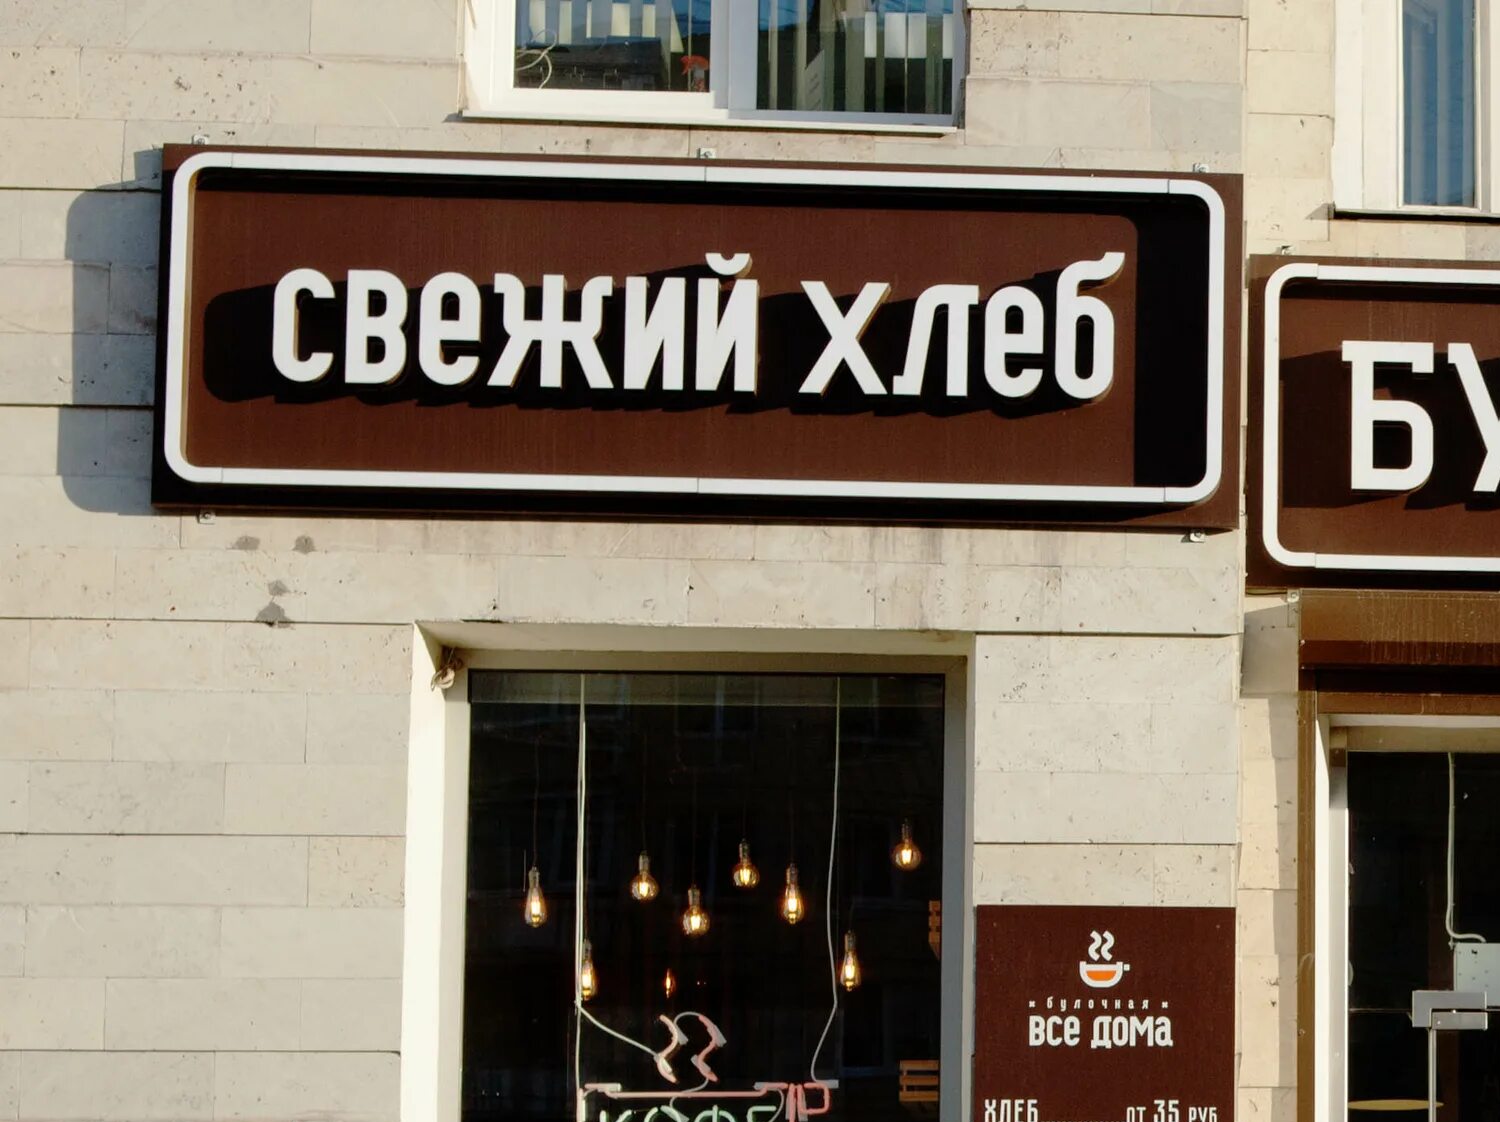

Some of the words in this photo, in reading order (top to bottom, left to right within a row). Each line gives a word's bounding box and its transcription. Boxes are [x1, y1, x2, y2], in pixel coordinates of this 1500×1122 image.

[272, 252, 758, 393] свежий
[798, 252, 1125, 399] хлеб
[1046, 996, 1149, 1012] булочная
[1028, 1015, 1081, 1047] все
[1090, 1015, 1174, 1049] дома
